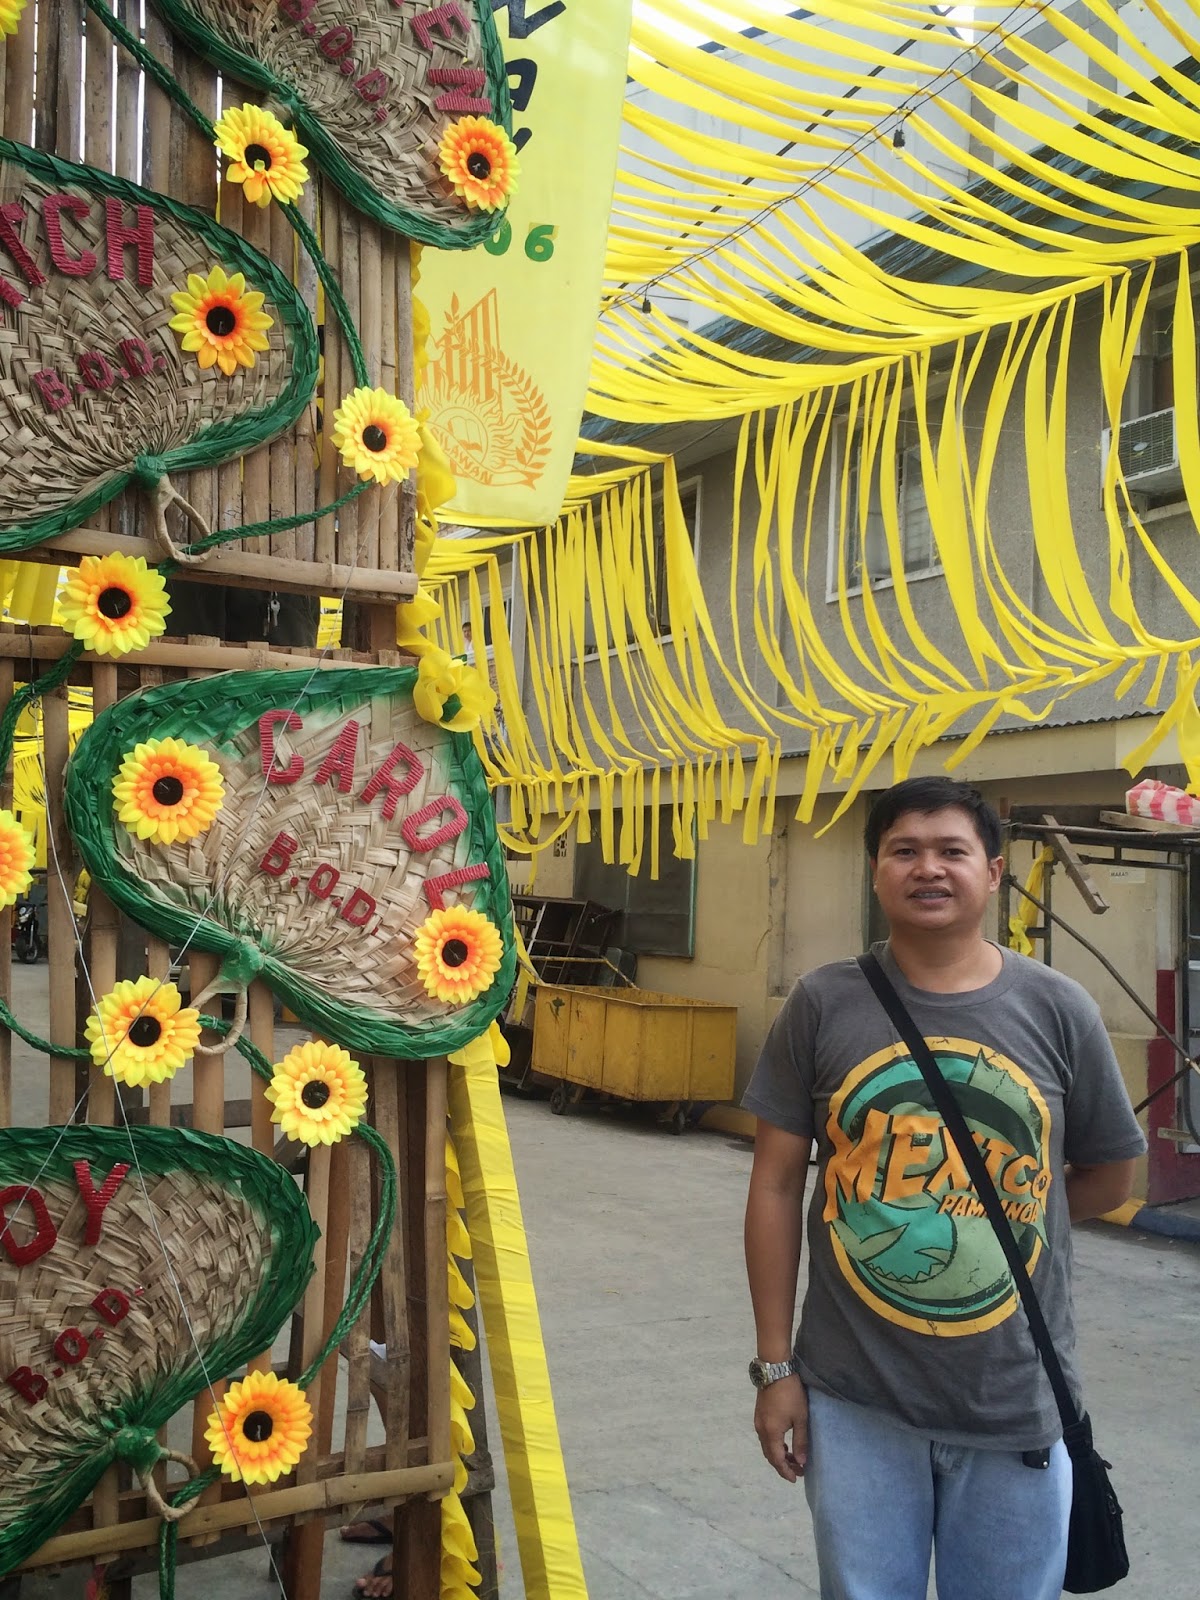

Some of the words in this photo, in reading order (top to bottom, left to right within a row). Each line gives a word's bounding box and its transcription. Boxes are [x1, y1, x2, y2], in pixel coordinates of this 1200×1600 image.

[33, 337, 167, 411] B.O.D.
[259, 709, 490, 911] CAROL
[259, 831, 379, 936] B.O.D.
[823, 1108, 1053, 1223] MEXICO
[936, 1194, 1039, 1225] PAMNGA
[6, 1285, 145, 1404] B.O.D.
